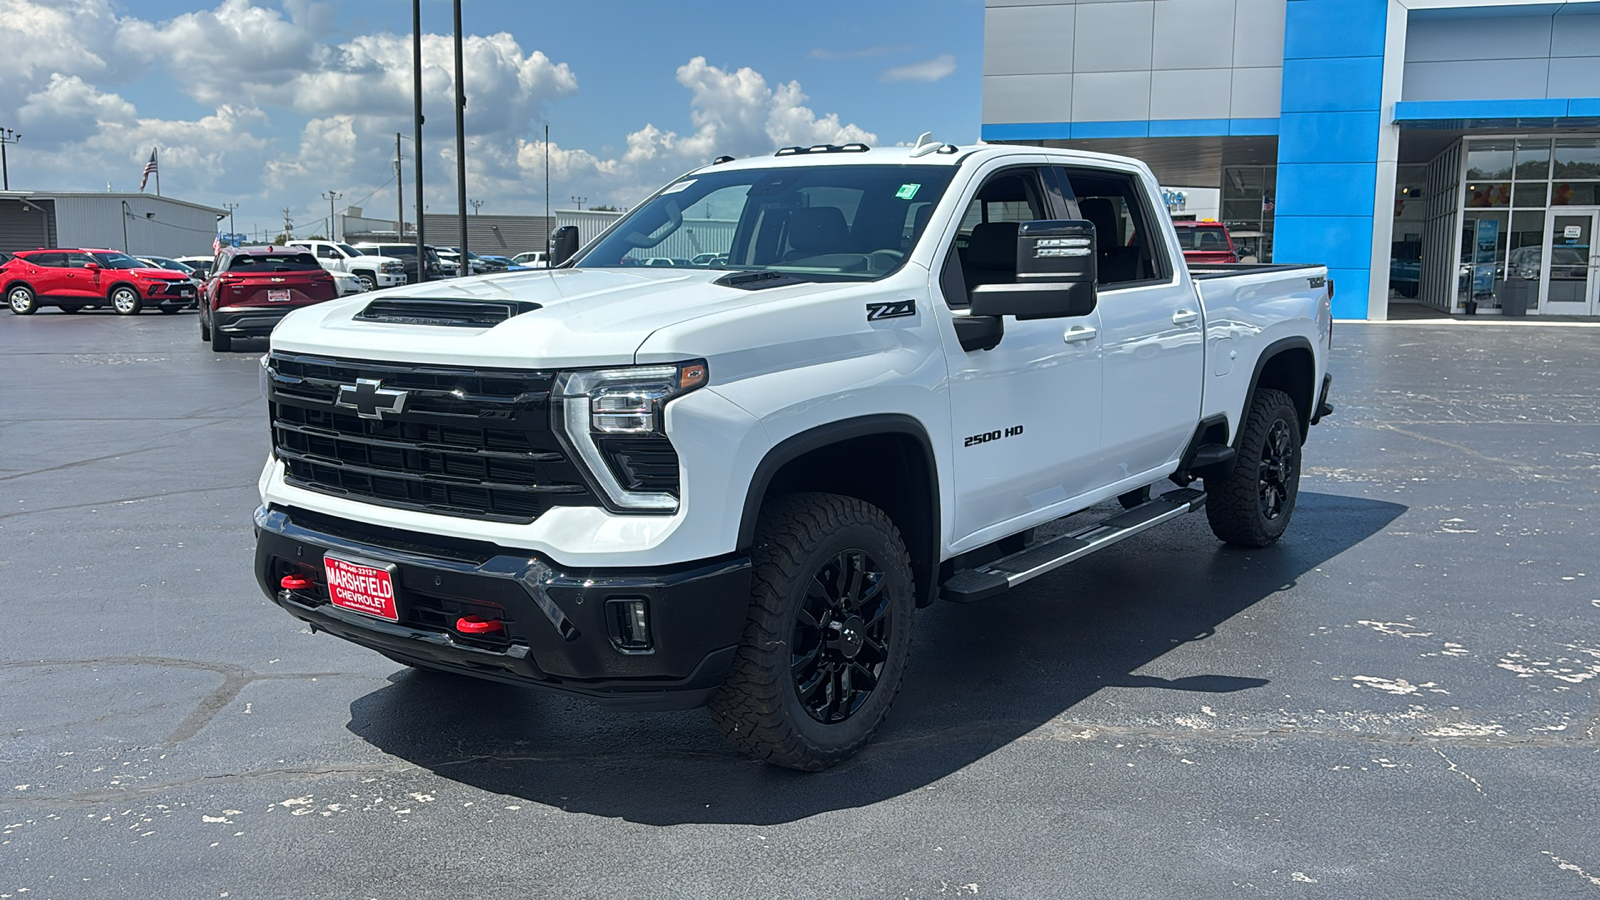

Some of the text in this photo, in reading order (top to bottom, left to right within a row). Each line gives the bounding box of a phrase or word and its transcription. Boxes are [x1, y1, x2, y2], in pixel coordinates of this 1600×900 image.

[964, 425, 1024, 448] 2500 HD
[326, 566, 392, 599] MARSHFIELD
[336, 587, 386, 609] CHEVROLET
